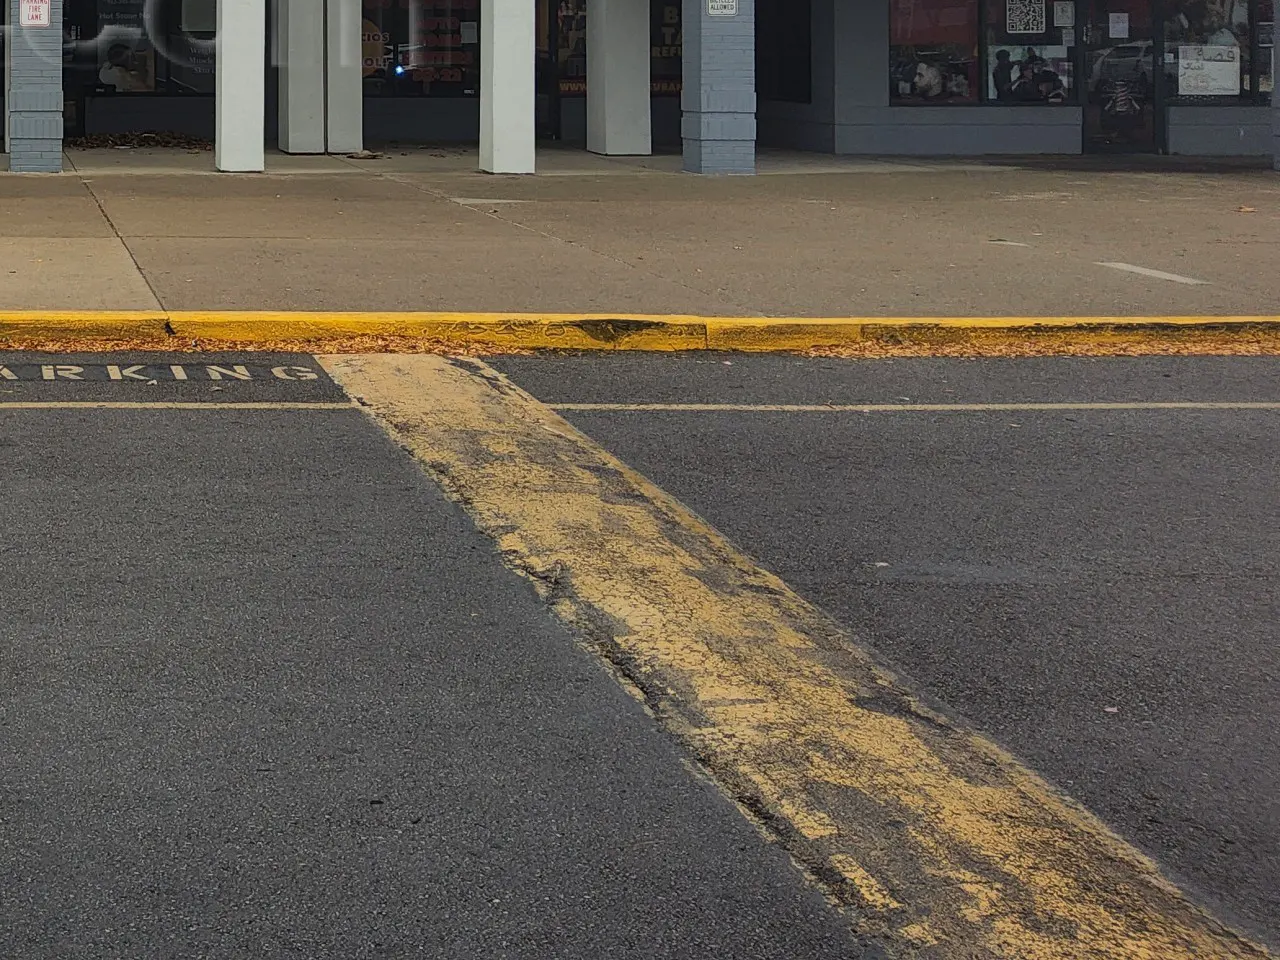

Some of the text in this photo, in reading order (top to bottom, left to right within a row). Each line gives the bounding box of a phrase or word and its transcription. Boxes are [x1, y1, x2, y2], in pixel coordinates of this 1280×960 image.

[28, 5, 41, 13] FIRE
[28, 13, 43, 21] LANE
[362, 33, 389, 43] CIOS
